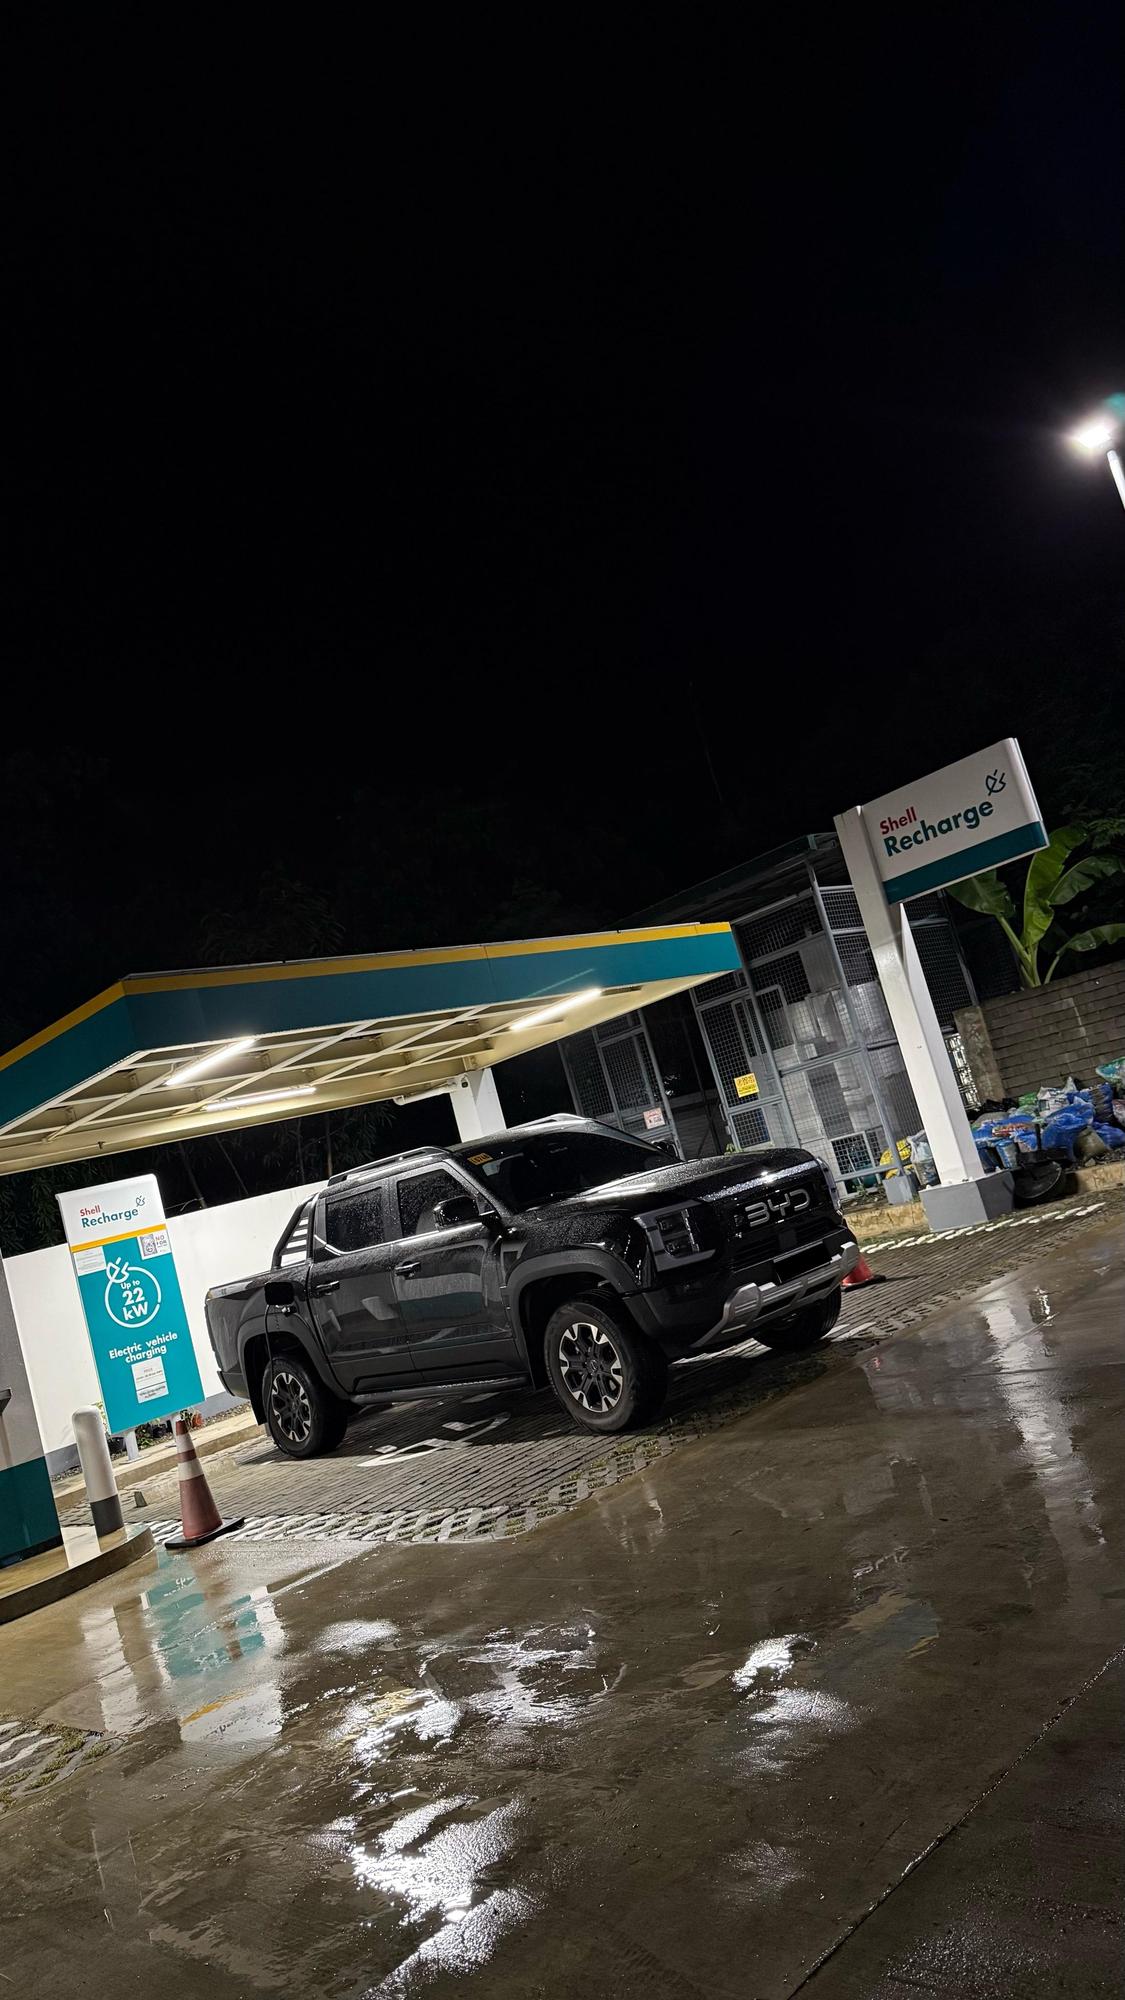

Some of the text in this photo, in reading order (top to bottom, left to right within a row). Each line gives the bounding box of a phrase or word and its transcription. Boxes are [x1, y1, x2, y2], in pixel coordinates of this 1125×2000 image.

[879, 806, 917, 835] Shell
[883, 800, 994, 857] Recharge
[80, 1205, 101, 1217] Shell
[745, 1188, 810, 1227] BYD
[81, 1208, 139, 1228] Recharge
[121, 1282, 131, 1290] Up
[122, 1287, 145, 1306] 22
[122, 1301, 148, 1321] kW
[109, 1331, 178, 1359] Electric vehicle
[125, 1345, 167, 1363] charging
